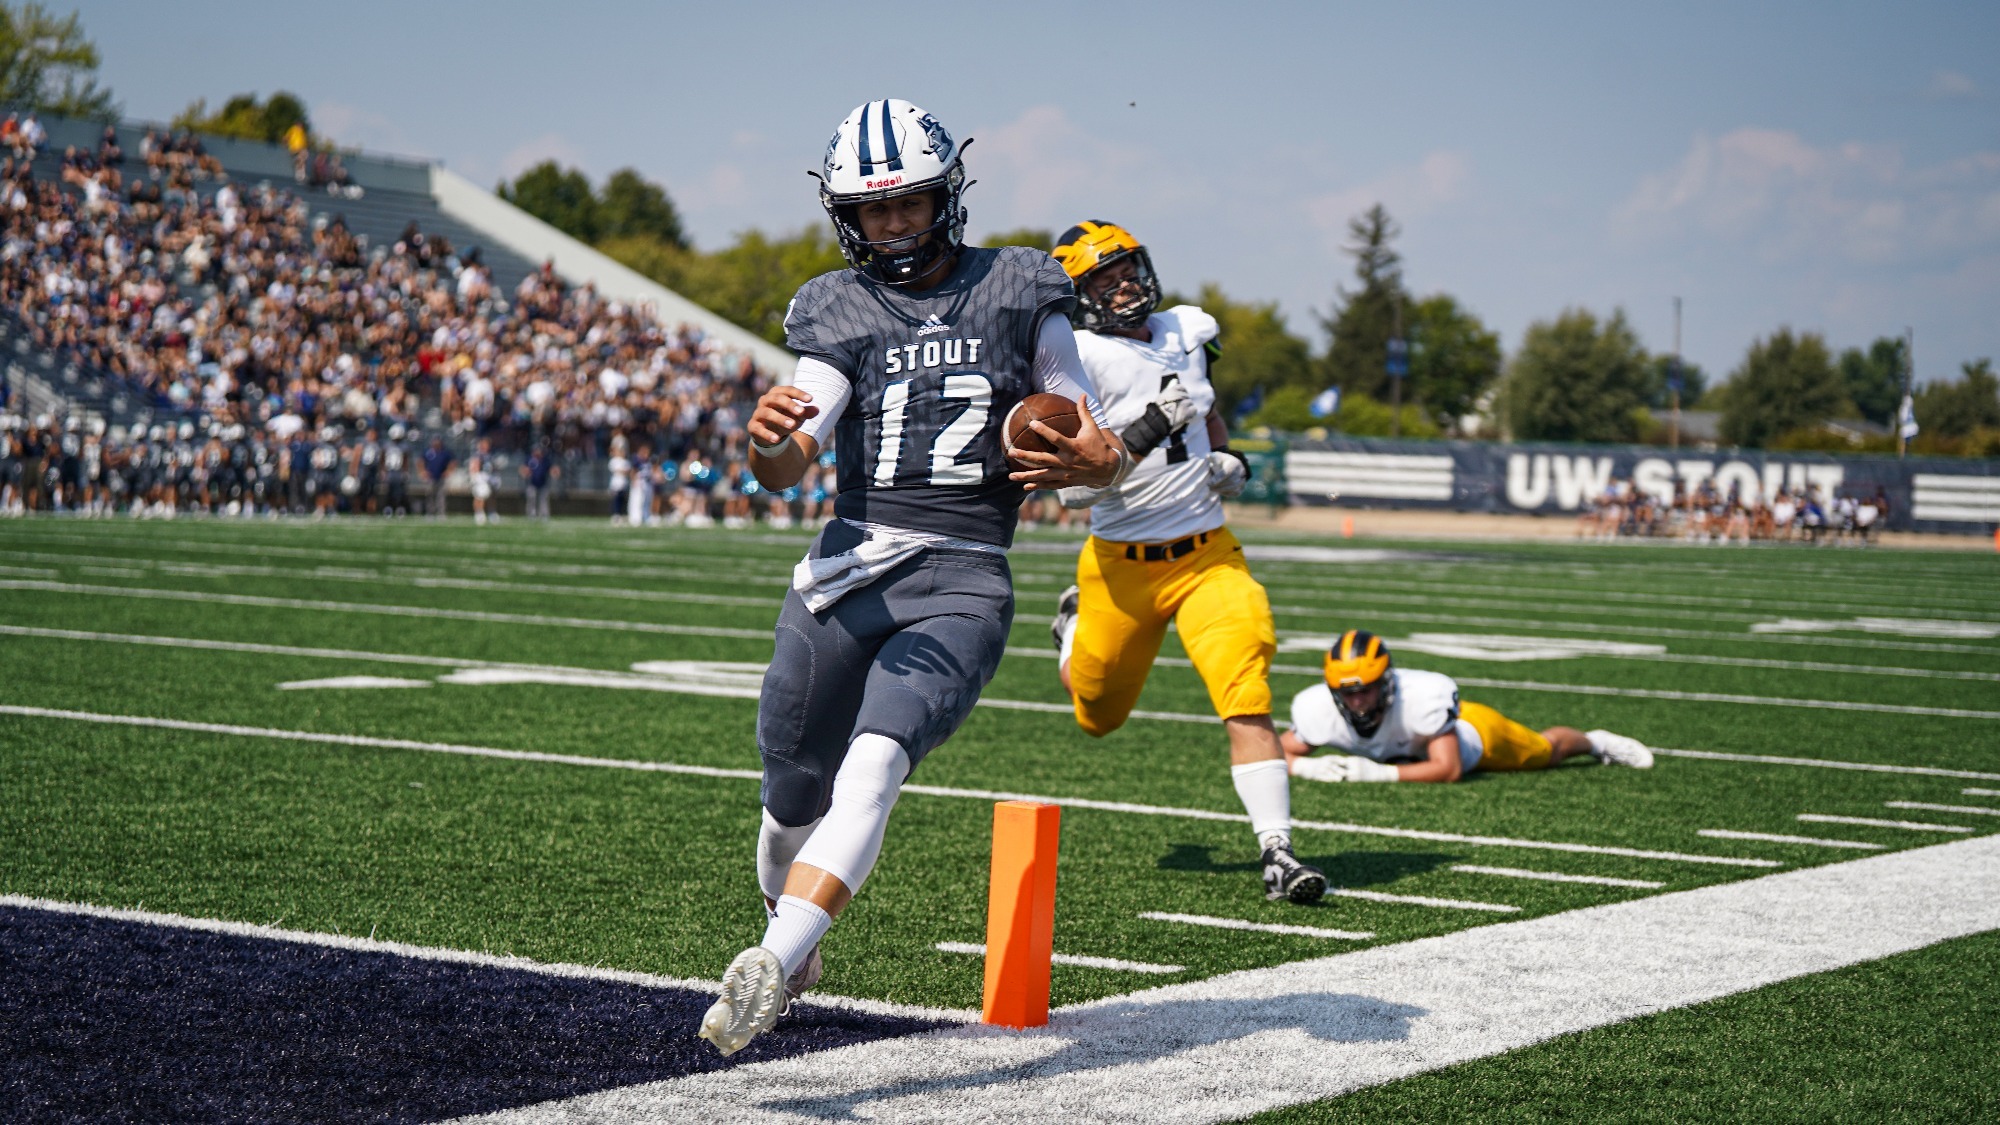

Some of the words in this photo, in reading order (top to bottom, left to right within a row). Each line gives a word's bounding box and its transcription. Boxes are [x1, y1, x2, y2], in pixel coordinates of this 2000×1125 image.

[866, 175, 903, 189] Riddell
[917, 324, 950, 336] adidas
[885, 338, 983, 374] STOUT
[873, 373, 993, 487] 12
